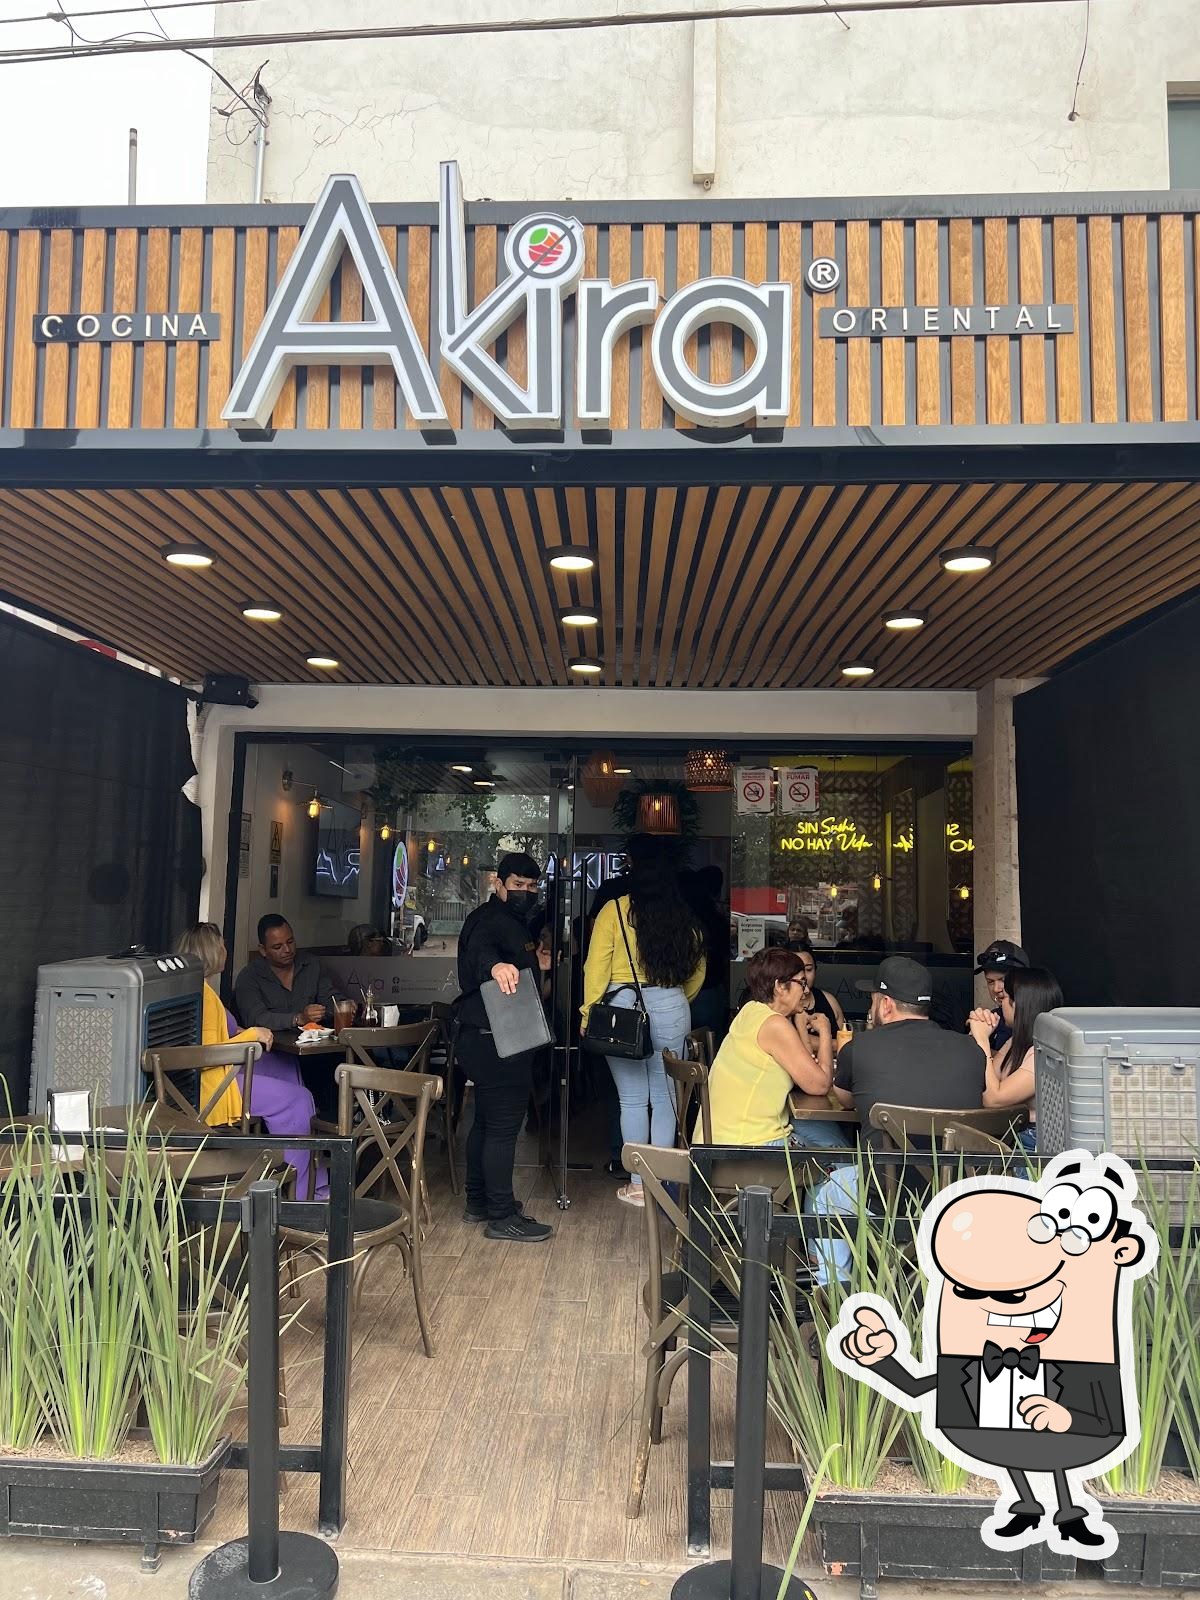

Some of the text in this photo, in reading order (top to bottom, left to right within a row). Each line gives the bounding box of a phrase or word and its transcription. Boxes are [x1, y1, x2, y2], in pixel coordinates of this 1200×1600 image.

[221, 160, 793, 430] Akira
[41, 314, 208, 338] COCINA
[832, 305, 1061, 332] ORIENTAL
[797, 822, 818, 834] SIN
[781, 832, 873, 851] NO HAY Vida
